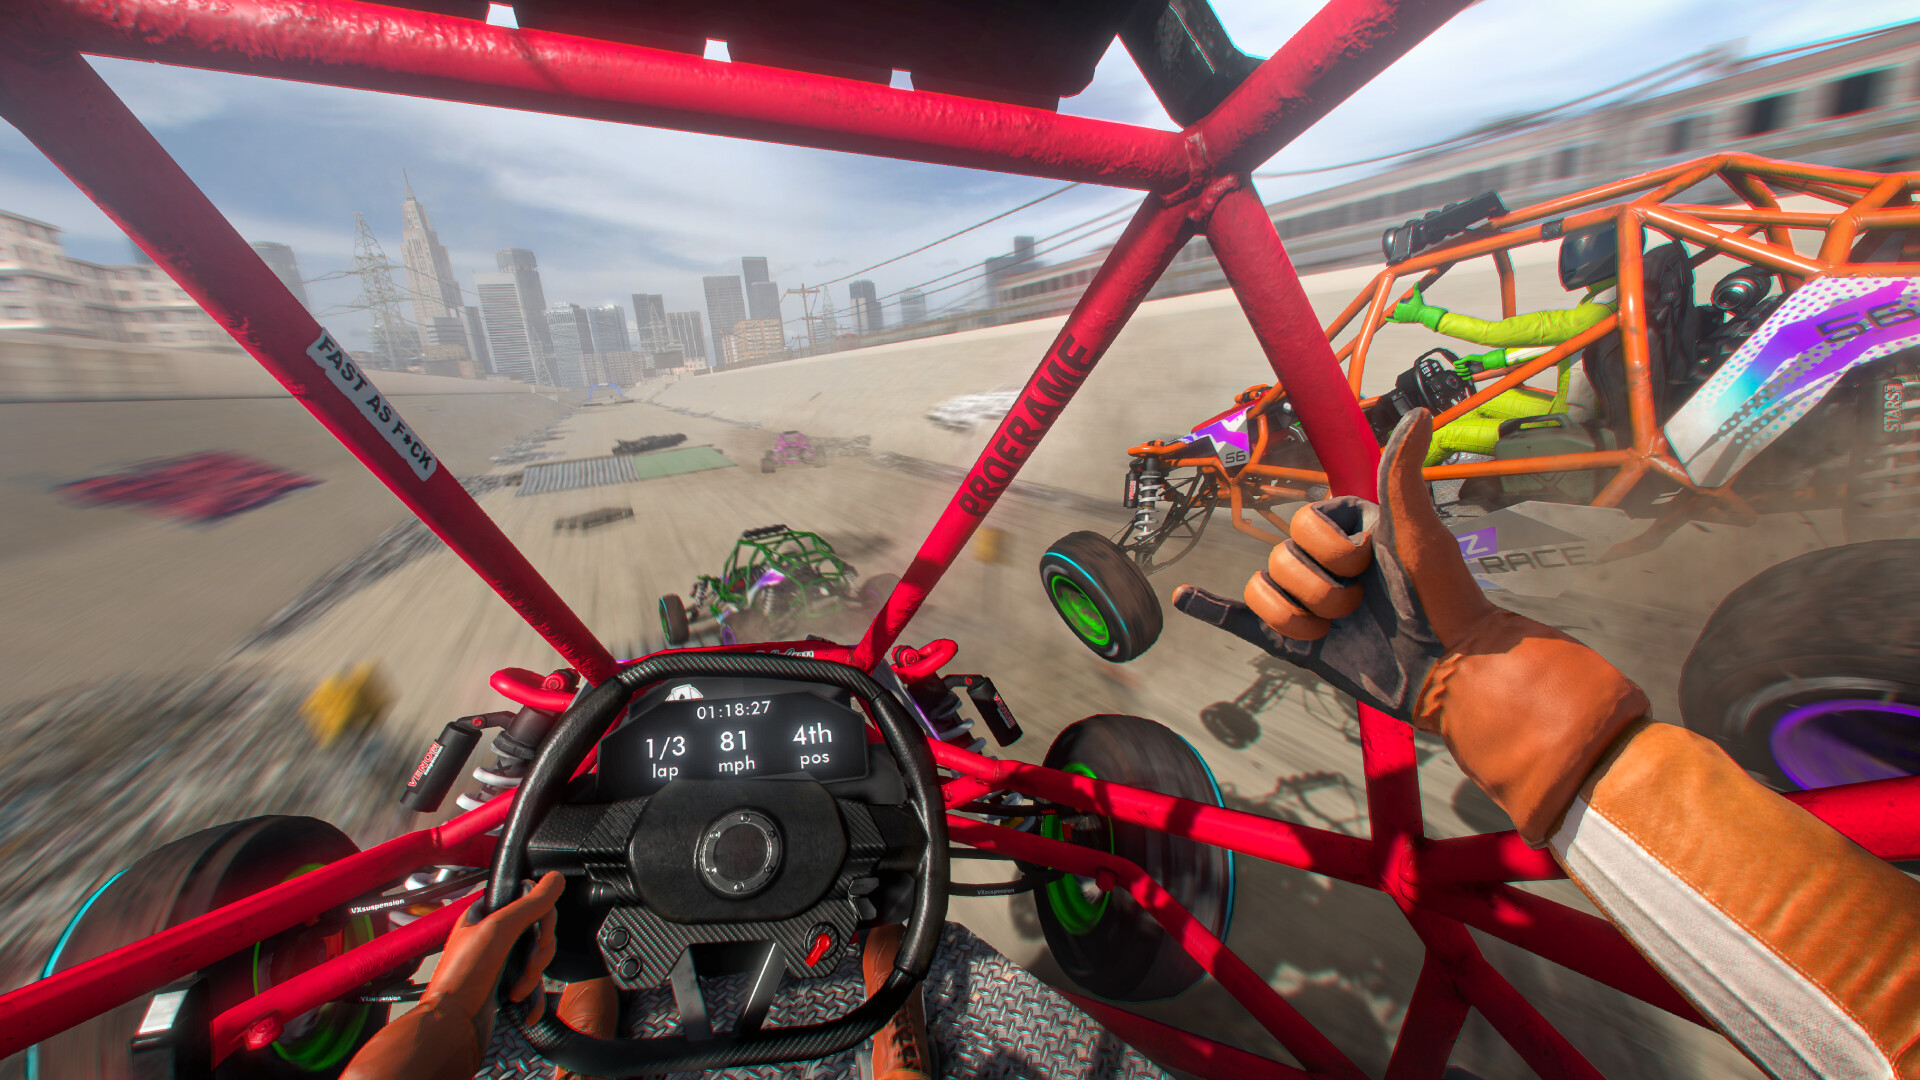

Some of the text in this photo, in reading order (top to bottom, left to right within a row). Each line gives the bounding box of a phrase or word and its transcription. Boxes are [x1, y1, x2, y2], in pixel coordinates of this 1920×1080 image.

[1815, 300, 1920, 343] 56
[316, 335, 368, 392] FAST
[365, 394, 392, 423] AS
[1883, 390, 1903, 432] STARS
[957, 333, 1104, 517] PROFRAME
[1226, 450, 1246, 464] 56
[1477, 546, 1595, 574] RACE
[696, 700, 772, 720] 01:18:27
[719, 730, 748, 752] 81
[792, 722, 833, 746] 4th
[645, 735, 687, 761] 1/3
[406, 741, 440, 788] VENOM
[651, 763, 680, 781] lap
[718, 755, 756, 776] mph
[799, 753, 831, 770] pos
[348, 898, 406, 915] VXsuspension
